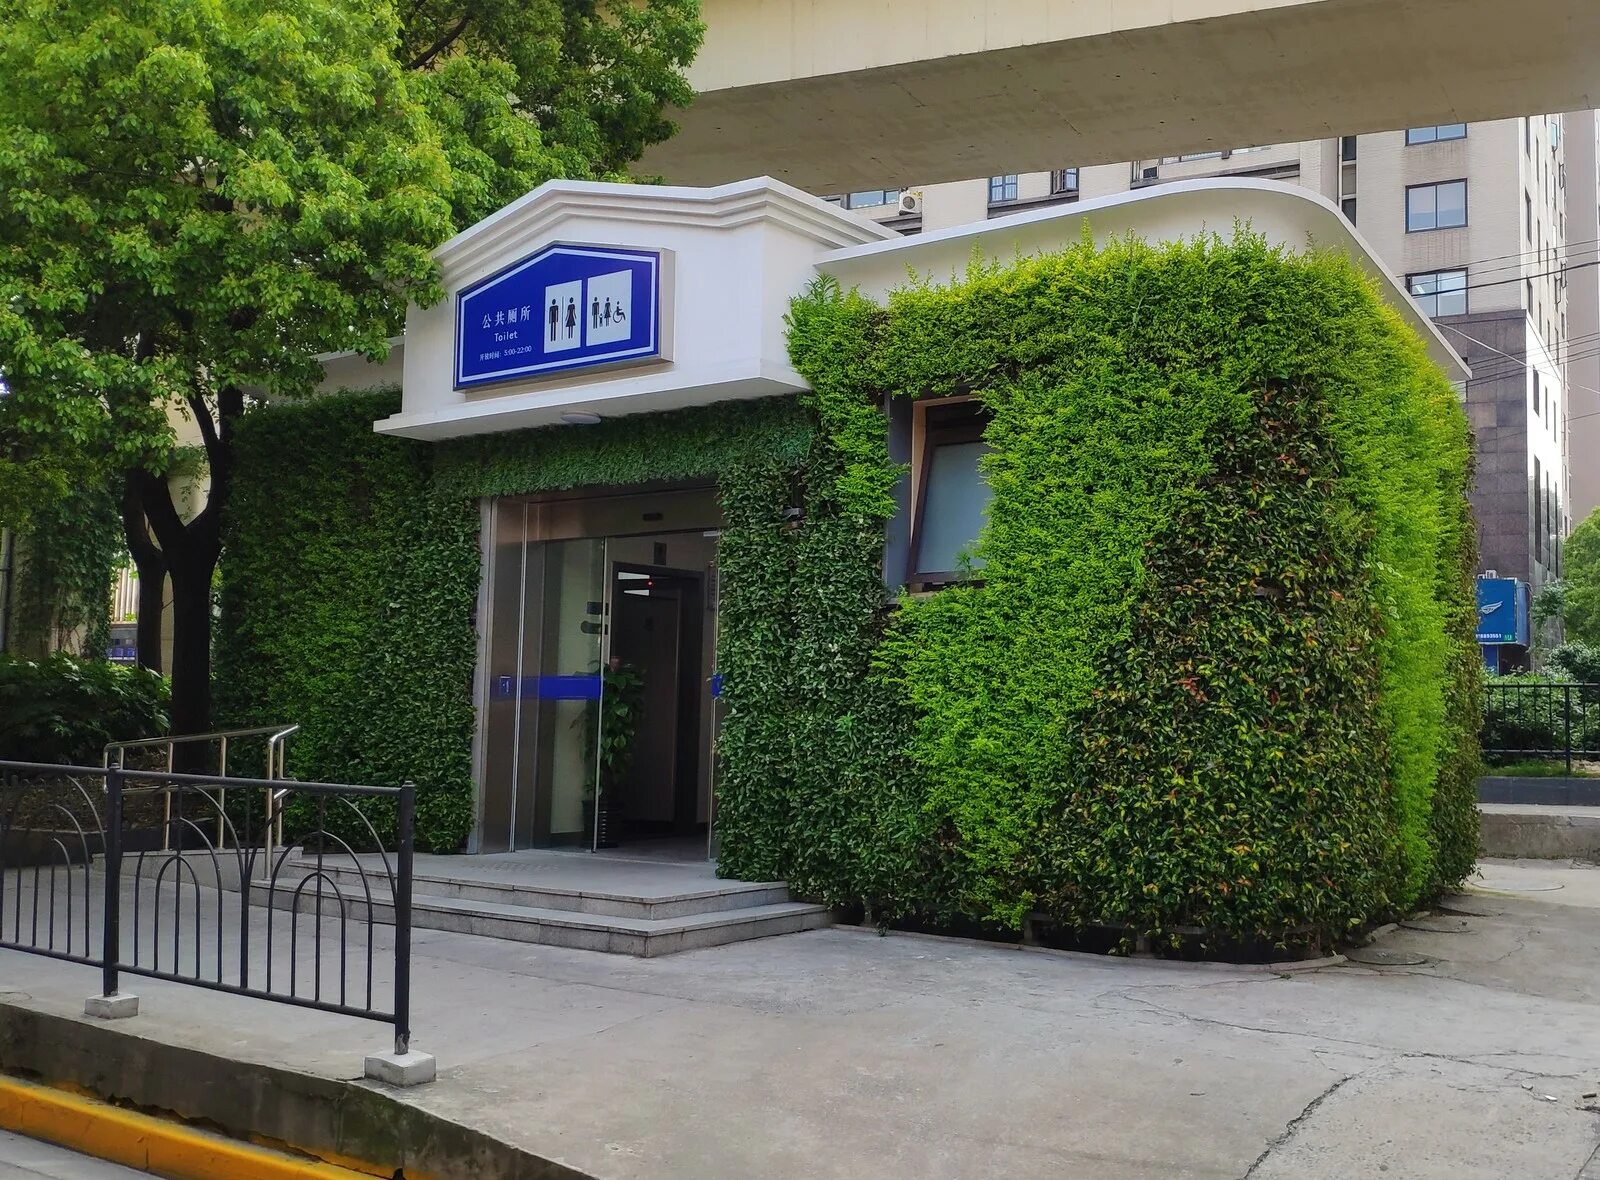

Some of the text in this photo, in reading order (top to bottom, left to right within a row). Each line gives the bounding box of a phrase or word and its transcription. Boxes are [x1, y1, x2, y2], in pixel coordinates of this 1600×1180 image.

[482, 305, 531, 329] 公共厕所
[494, 330, 518, 342] Toilet
